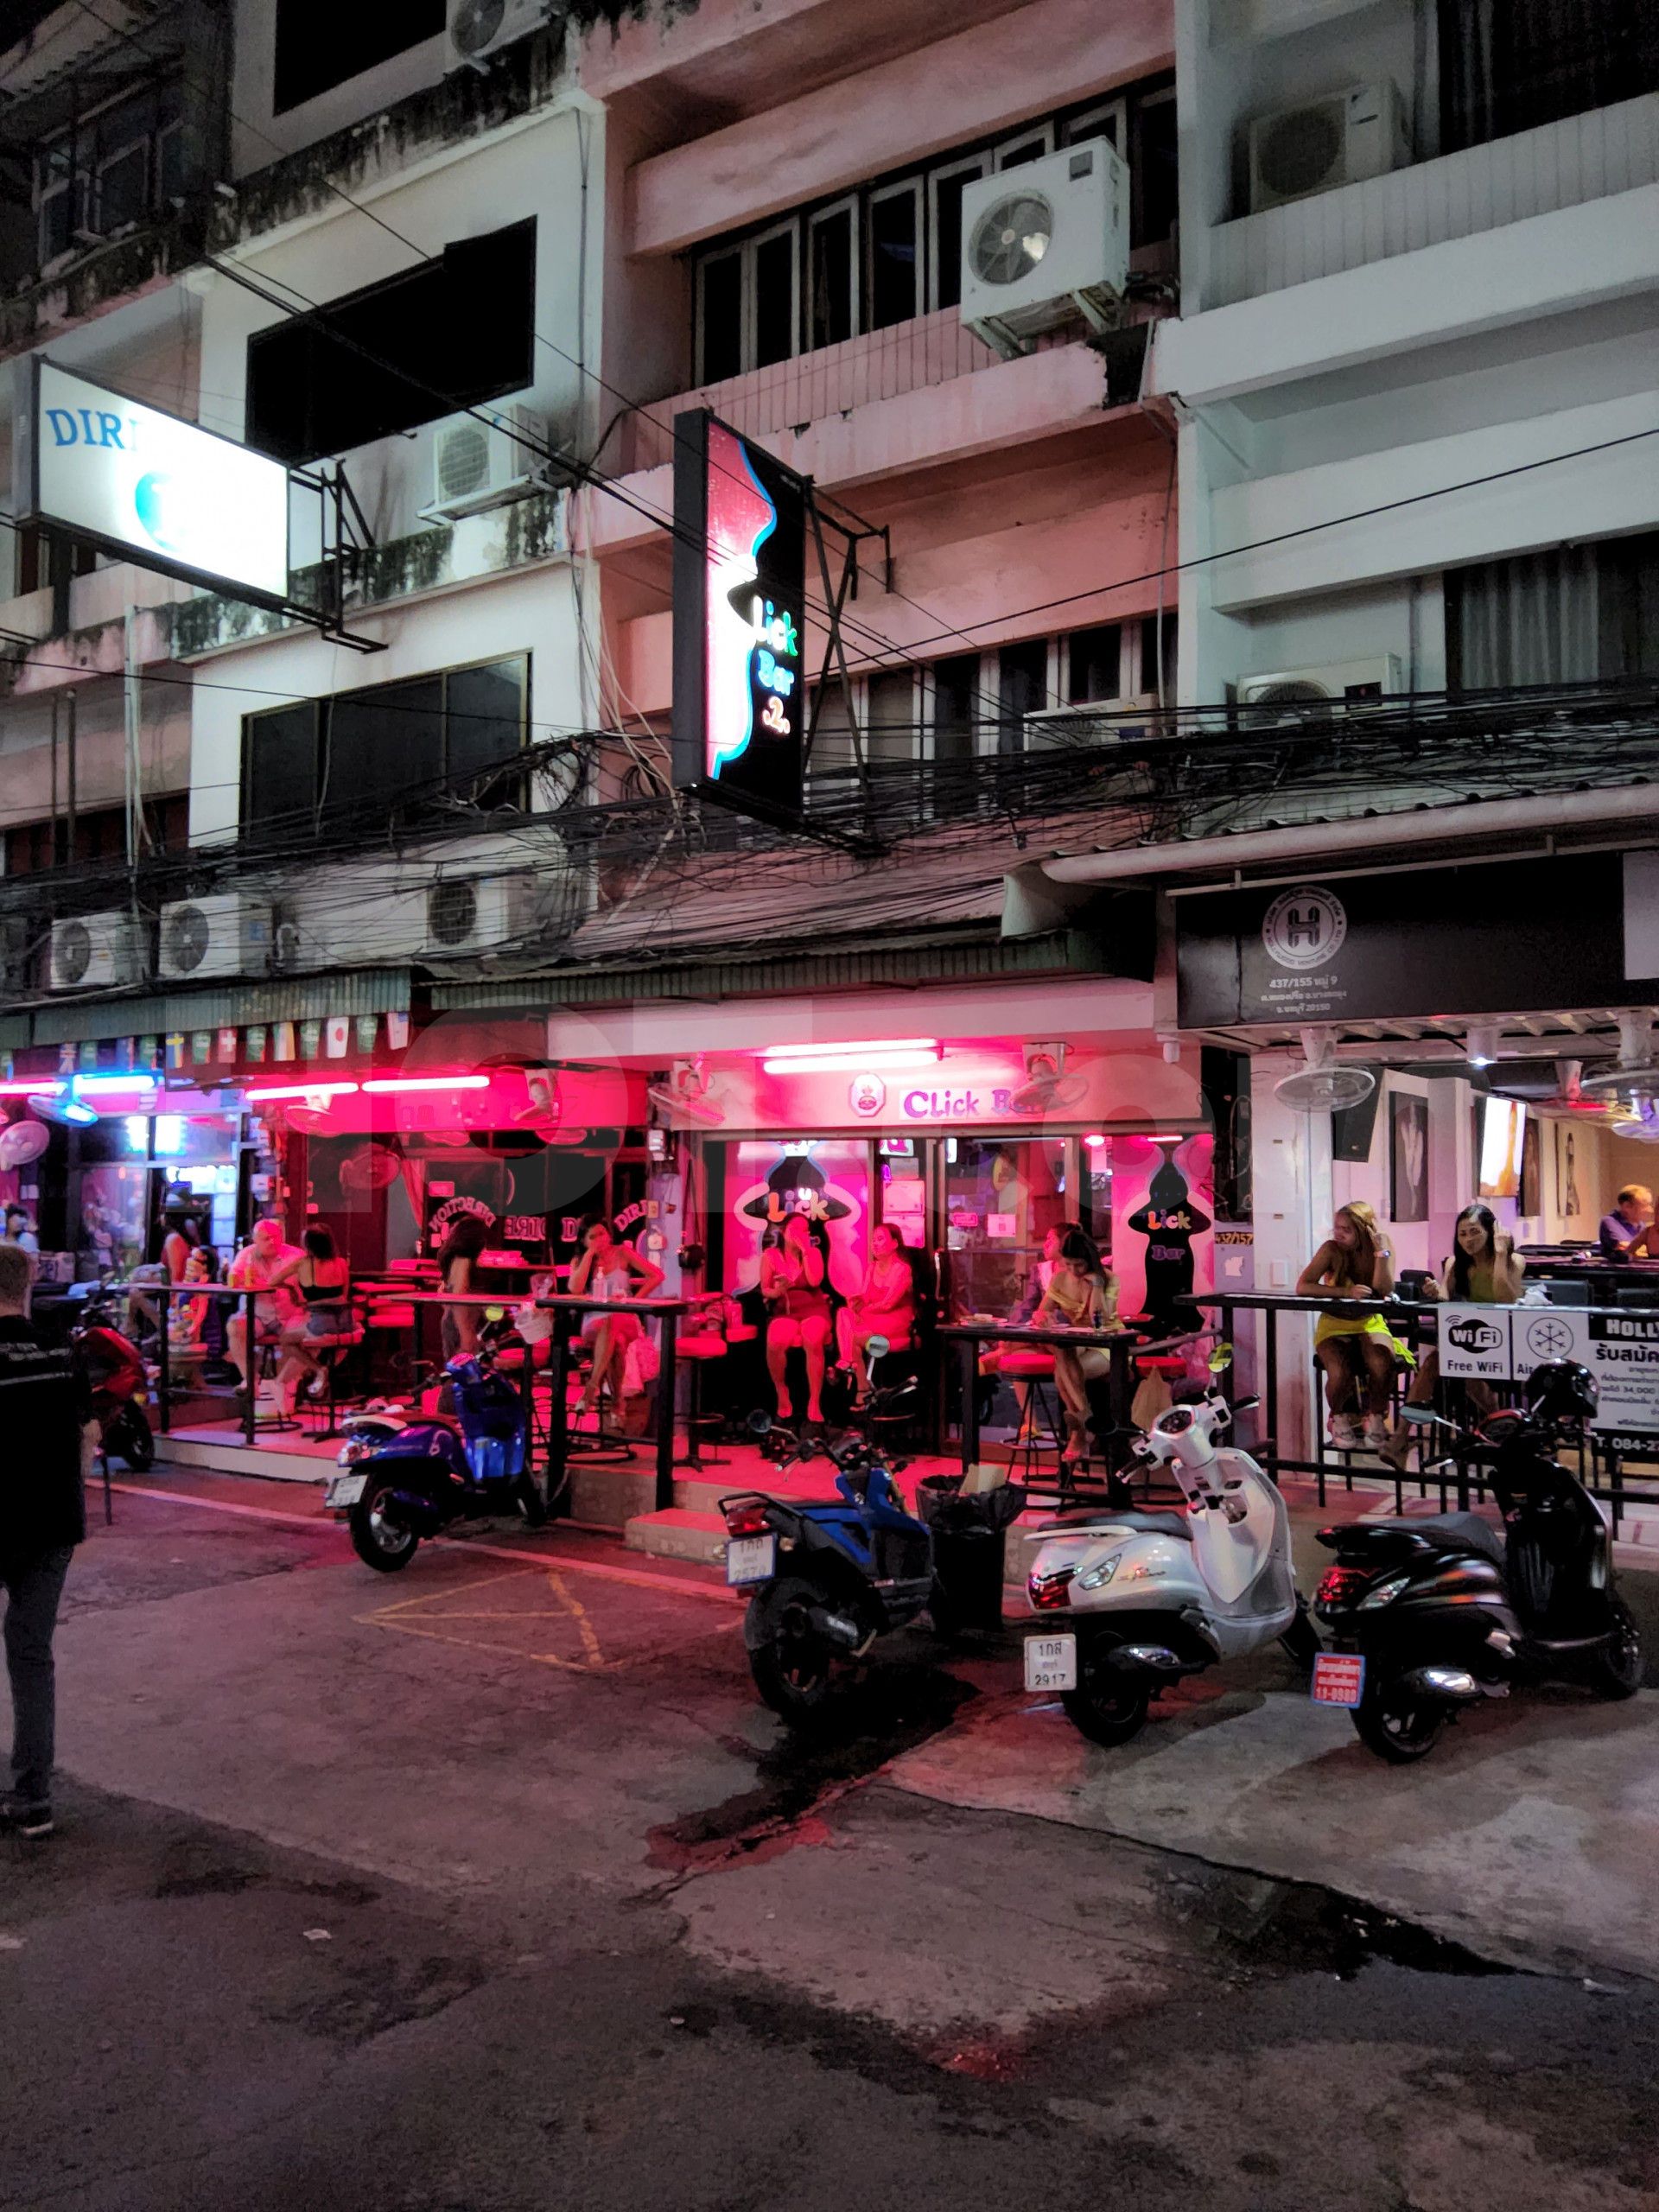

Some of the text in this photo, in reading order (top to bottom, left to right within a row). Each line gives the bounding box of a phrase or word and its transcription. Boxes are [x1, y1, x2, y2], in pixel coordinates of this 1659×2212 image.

[1269, 976, 1312, 988] 437/155
[1331, 975, 1338, 985] 9
[1147, 1209, 1192, 1230] Lick
[1151, 1244, 1185, 1261] Bar
[1605, 1319, 1659, 1338] HOLL
[1447, 1359, 1503, 1373] Free WiFi
[1035, 1673, 1066, 1686] 2917
